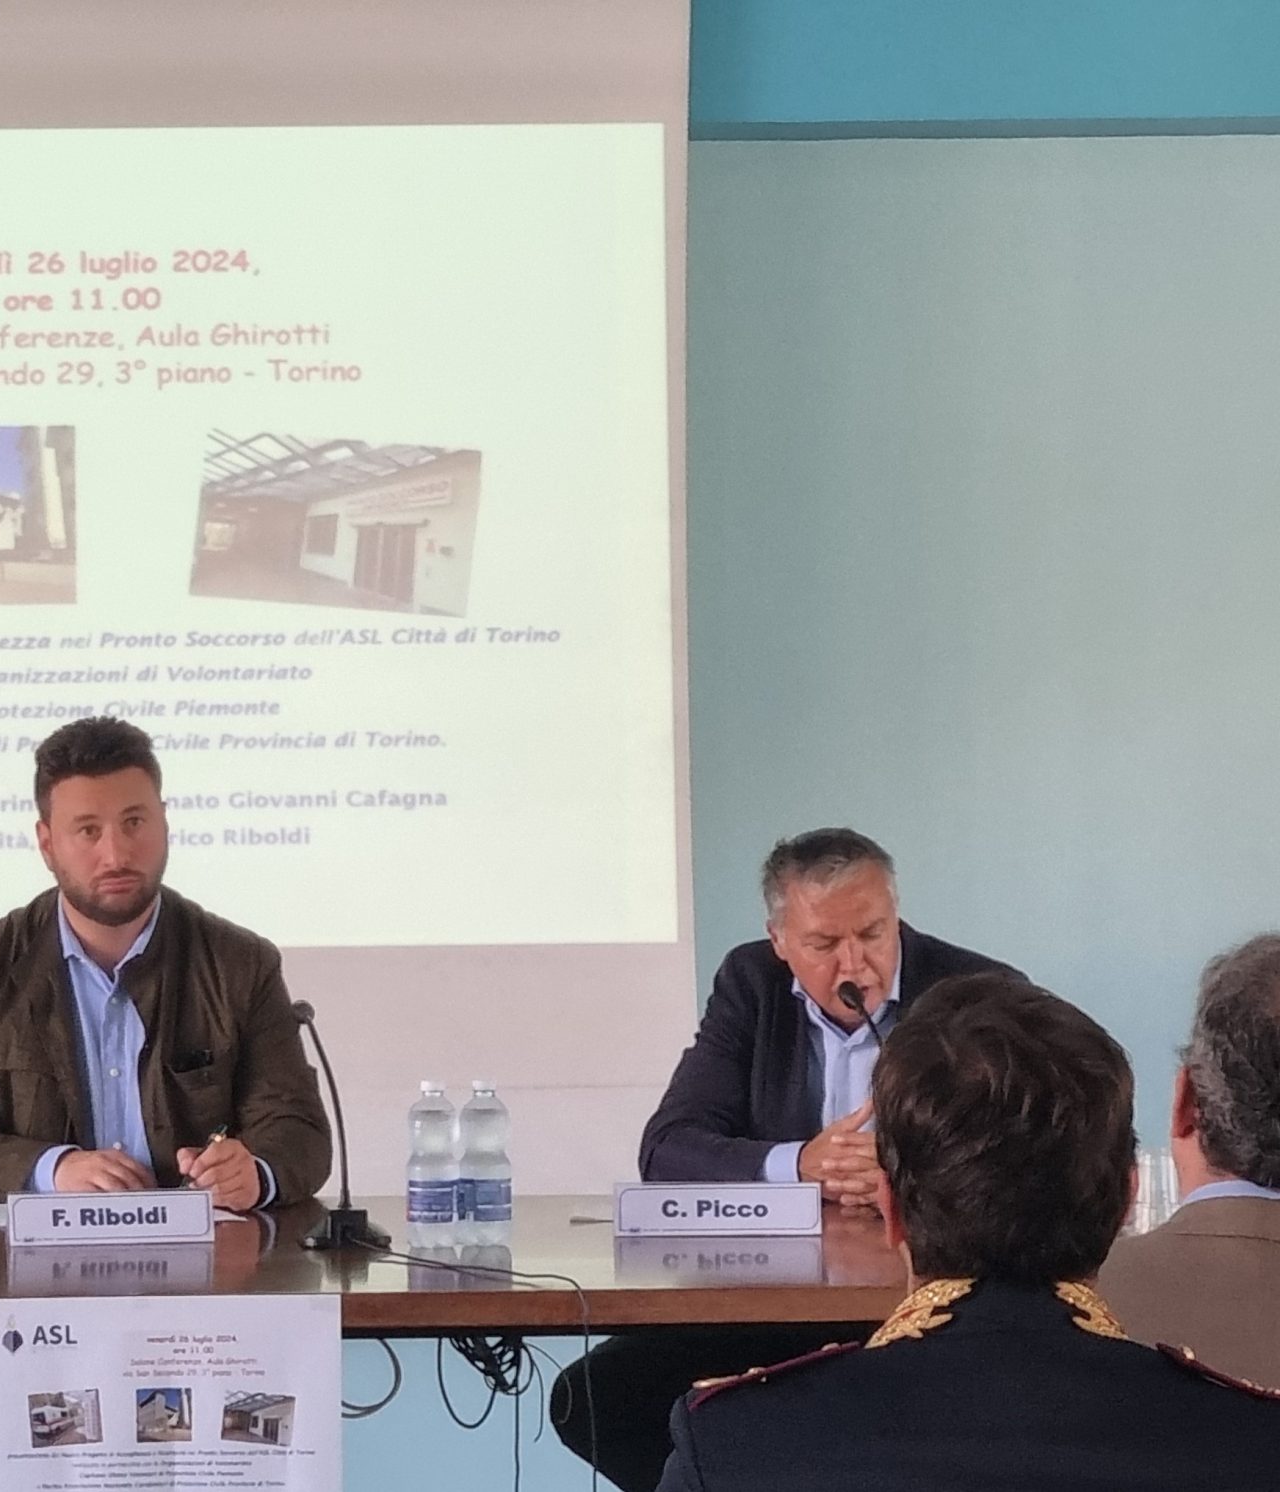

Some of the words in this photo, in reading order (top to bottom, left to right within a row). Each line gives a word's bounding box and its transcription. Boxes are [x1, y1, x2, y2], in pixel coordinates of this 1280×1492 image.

[27, 251, 66, 275] 26
[80, 250, 158, 280] luglio
[172, 249, 261, 277] 2024,
[3, 295, 53, 312] ore
[70, 287, 162, 311] 11.00
[136, 323, 200, 347] Aula
[210, 322, 330, 347] Ghirotti
[57, 361, 103, 388] 29,
[115, 359, 147, 384] 3°
[157, 362, 232, 391] piano
[267, 359, 362, 383] Torino
[60, 635, 91, 648] nei
[100, 632, 176, 648] Pronto
[185, 631, 285, 647] Soccorso
[295, 629, 382, 646] dell'ASL
[391, 628, 446, 644] Città
[455, 627, 476, 643] di
[486, 626, 560, 643] Torino
[136, 665, 157, 681] di
[168, 664, 312, 681] Volontariato
[103, 700, 165, 717] Civile
[175, 700, 279, 716] Piemonte
[151, 734, 210, 750] Civile
[219, 732, 326, 749] Provincia
[335, 732, 356, 747] di
[366, 730, 446, 747] Torino.
[167, 793, 219, 810] nato
[229, 790, 337, 808] Giovanni
[346, 789, 447, 811] Cafagna
[224, 828, 309, 845] Riboldi
[52, 1208, 71, 1227] F.
[80, 1206, 168, 1226] Riboldi
[661, 1199, 688, 1218] C.
[696, 1200, 769, 1218] Picco
[32, 1324, 78, 1345] ASL
